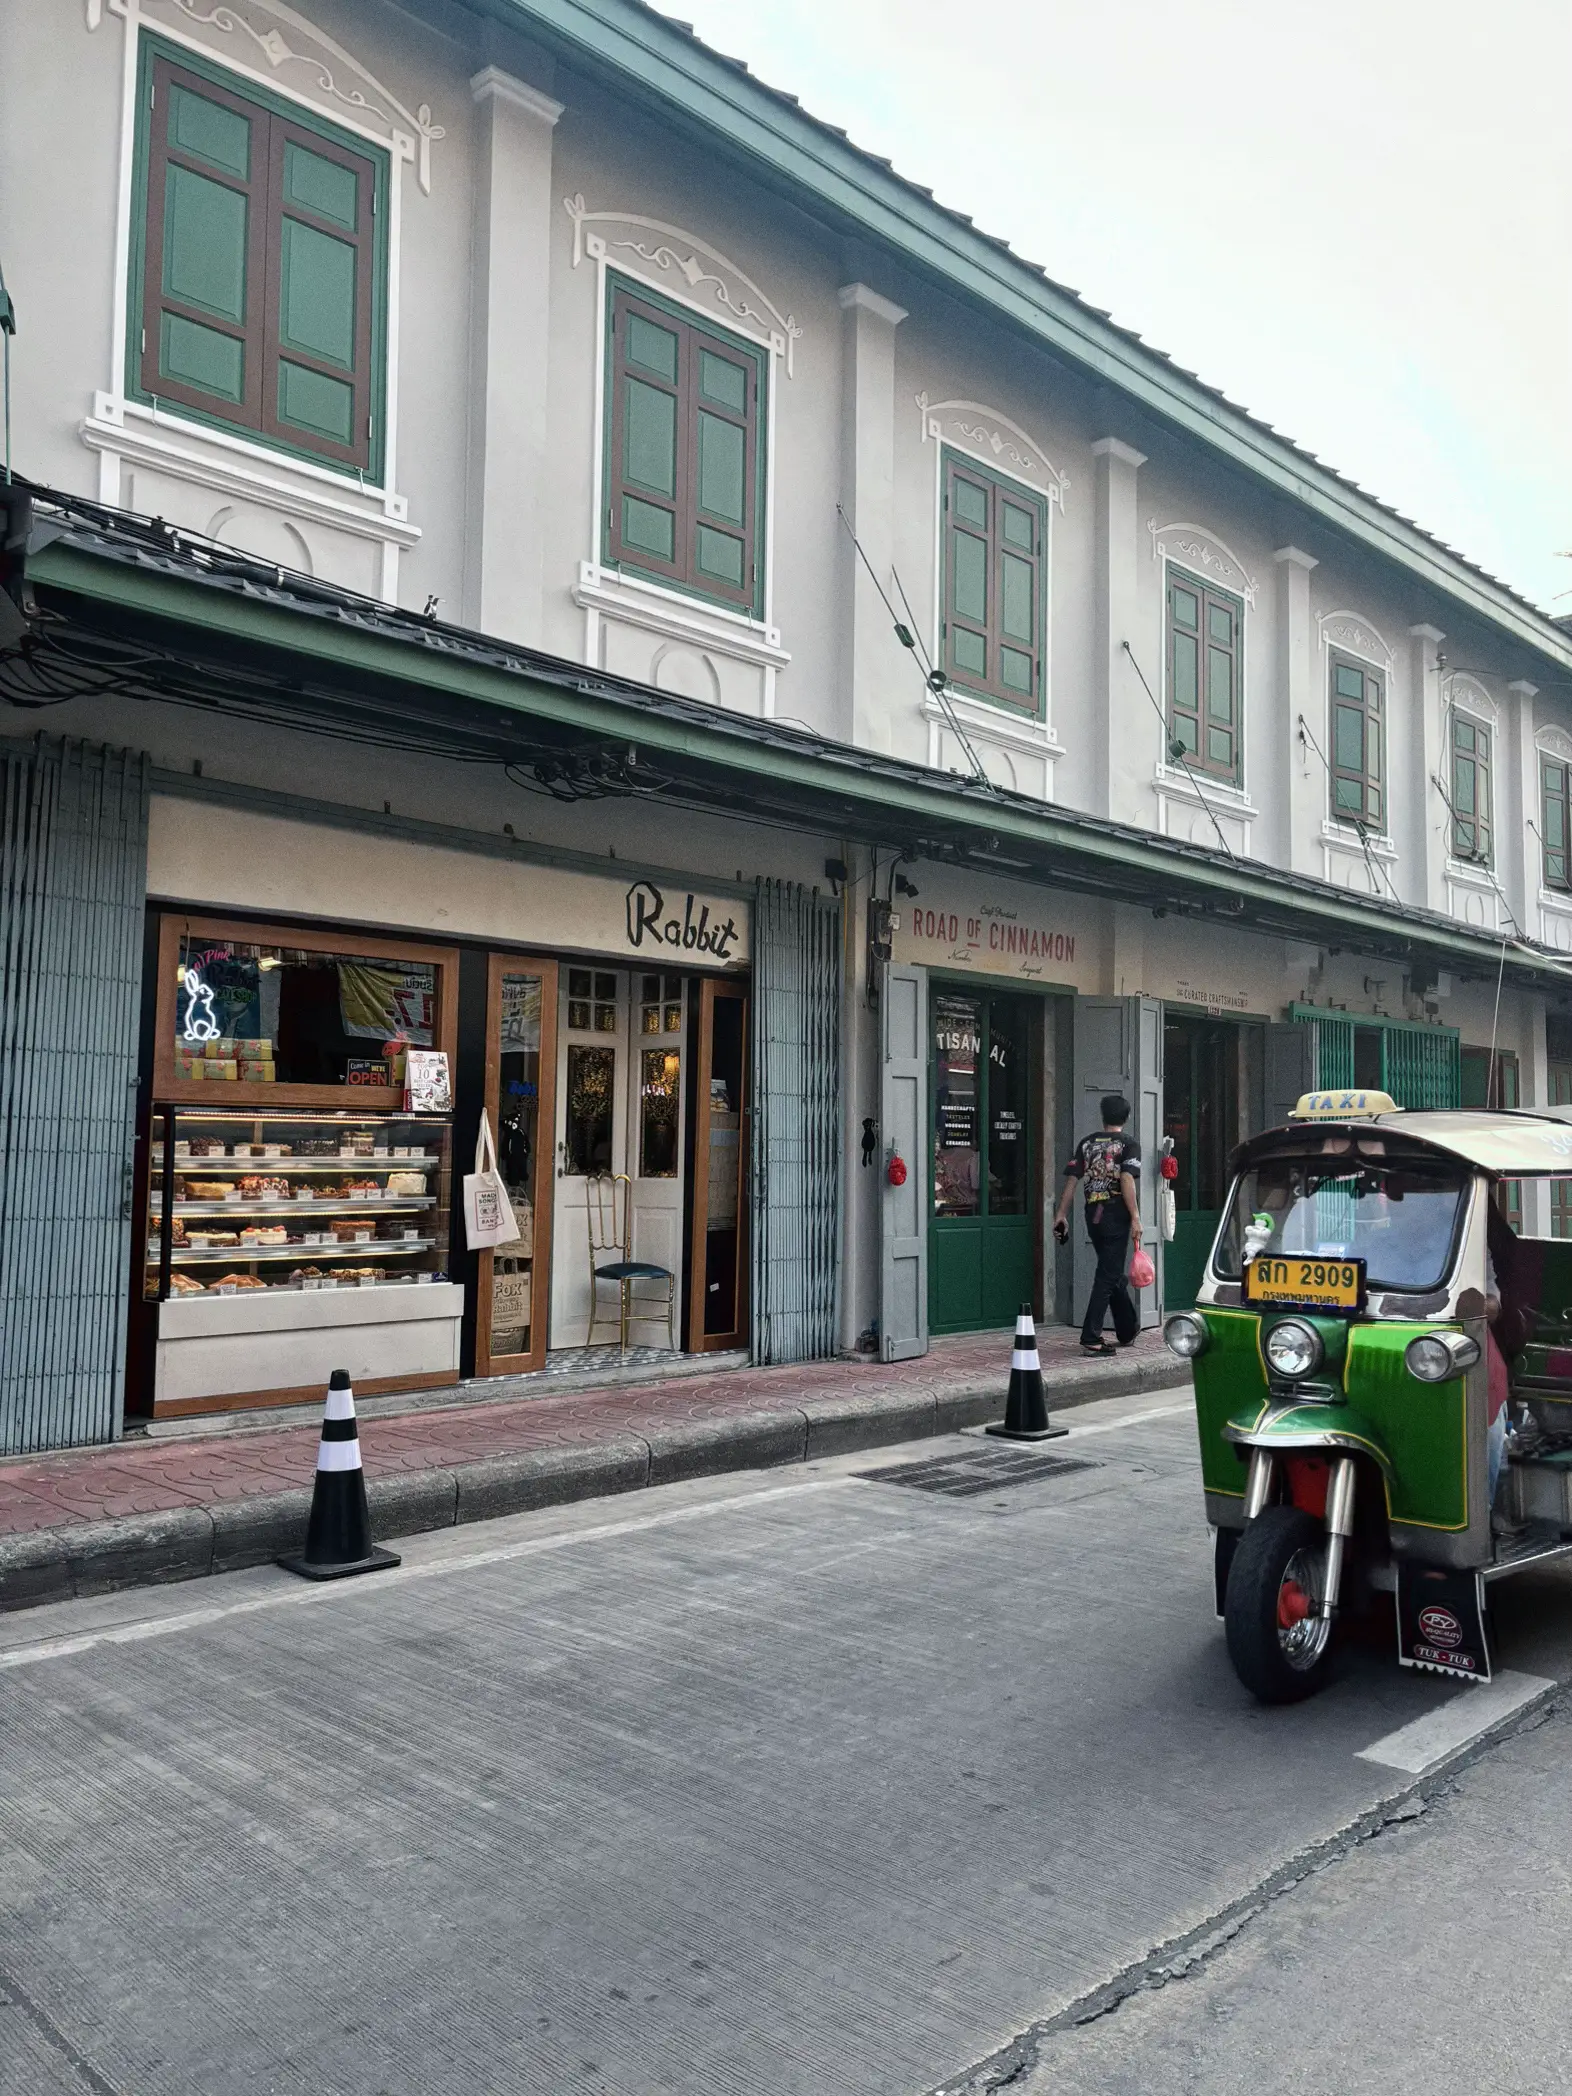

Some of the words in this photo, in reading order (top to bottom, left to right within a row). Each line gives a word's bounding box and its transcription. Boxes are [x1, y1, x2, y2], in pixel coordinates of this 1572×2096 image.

[626, 881, 739, 958] Rabbit
[913, 907, 959, 943] ROAD
[966, 917, 982, 939] OF
[989, 921, 1076, 963] CINNAMON
[349, 1072, 388, 1086] OPEN
[1307, 1093, 1367, 1111] TAXI
[1257, 1259, 1288, 1285] สก
[1300, 1263, 1355, 1288] 2909
[1419, 1647, 1440, 1660] TUK
[1448, 1653, 1470, 1667] TUK
